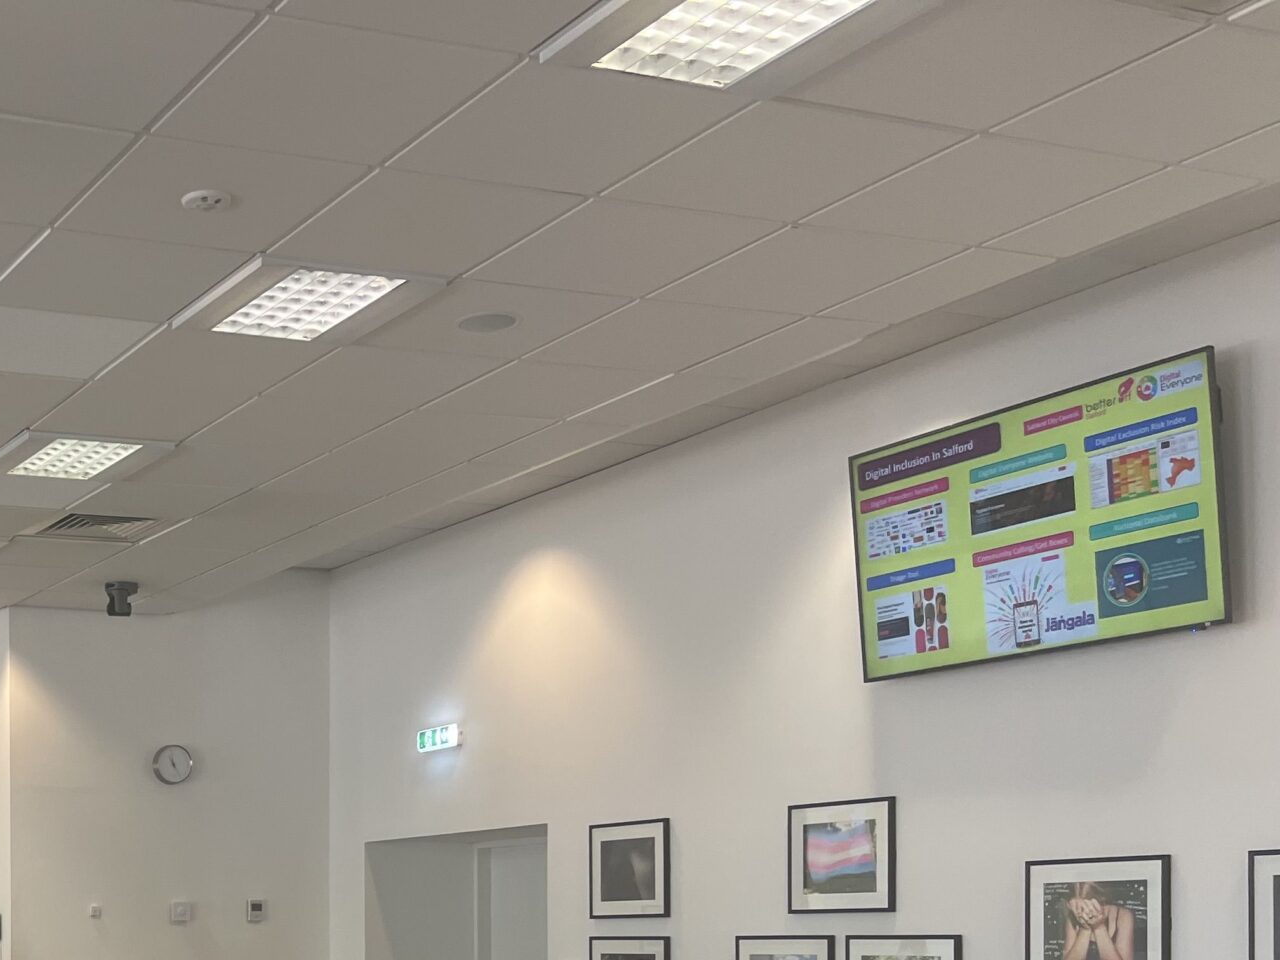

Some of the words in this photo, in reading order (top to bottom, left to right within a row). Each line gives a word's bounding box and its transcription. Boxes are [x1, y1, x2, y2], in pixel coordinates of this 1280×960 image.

[1160, 374, 1203, 391] Everyone
[1085, 397, 1116, 412] better
[1095, 434, 1118, 446] Digital
[1166, 416, 1187, 426] Index
[865, 464, 892, 480] Digital
[893, 455, 930, 472] Inclusion
[932, 452, 940, 460] In
[942, 440, 974, 458] Salford
